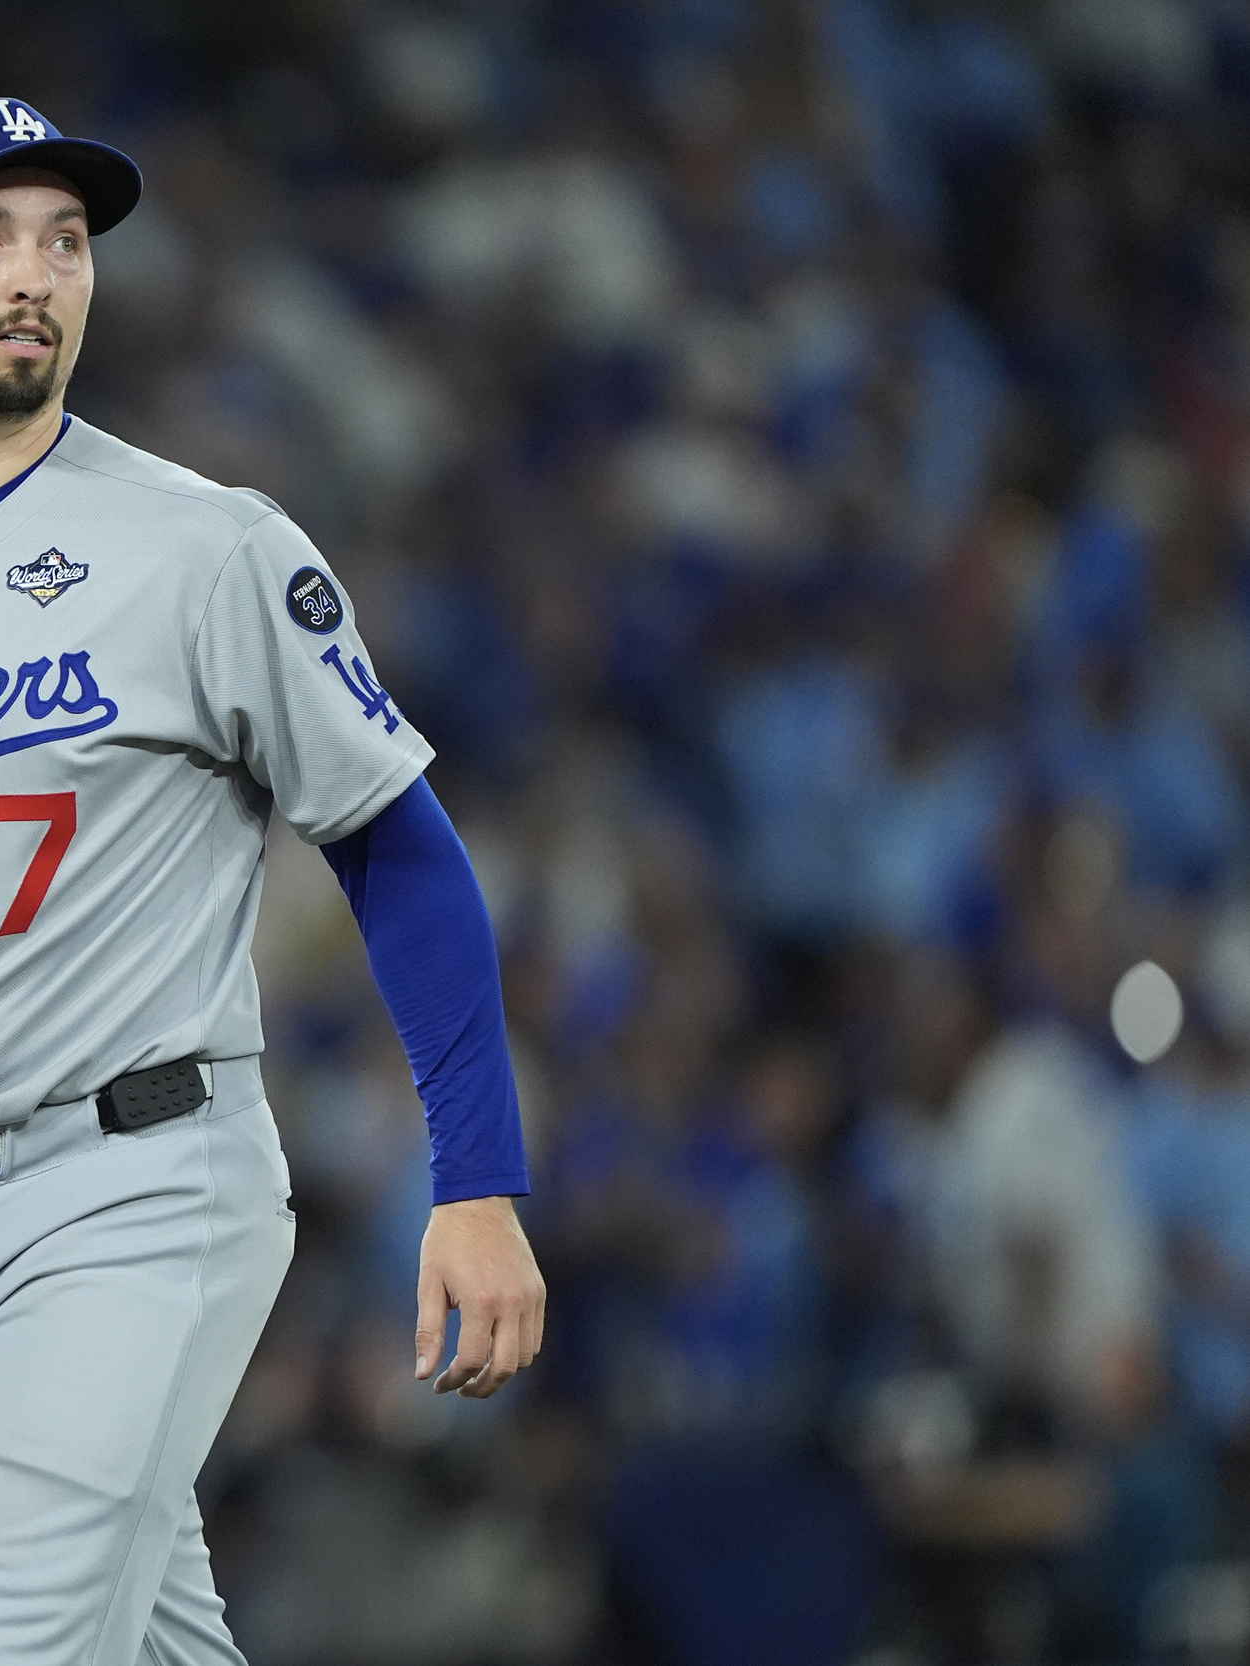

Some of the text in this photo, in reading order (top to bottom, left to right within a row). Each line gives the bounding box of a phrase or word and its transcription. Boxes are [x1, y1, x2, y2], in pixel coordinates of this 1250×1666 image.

[10, 565, 84, 588] World Series
[292, 575, 322, 601] FERNANDO
[302, 586, 337, 625] 34
